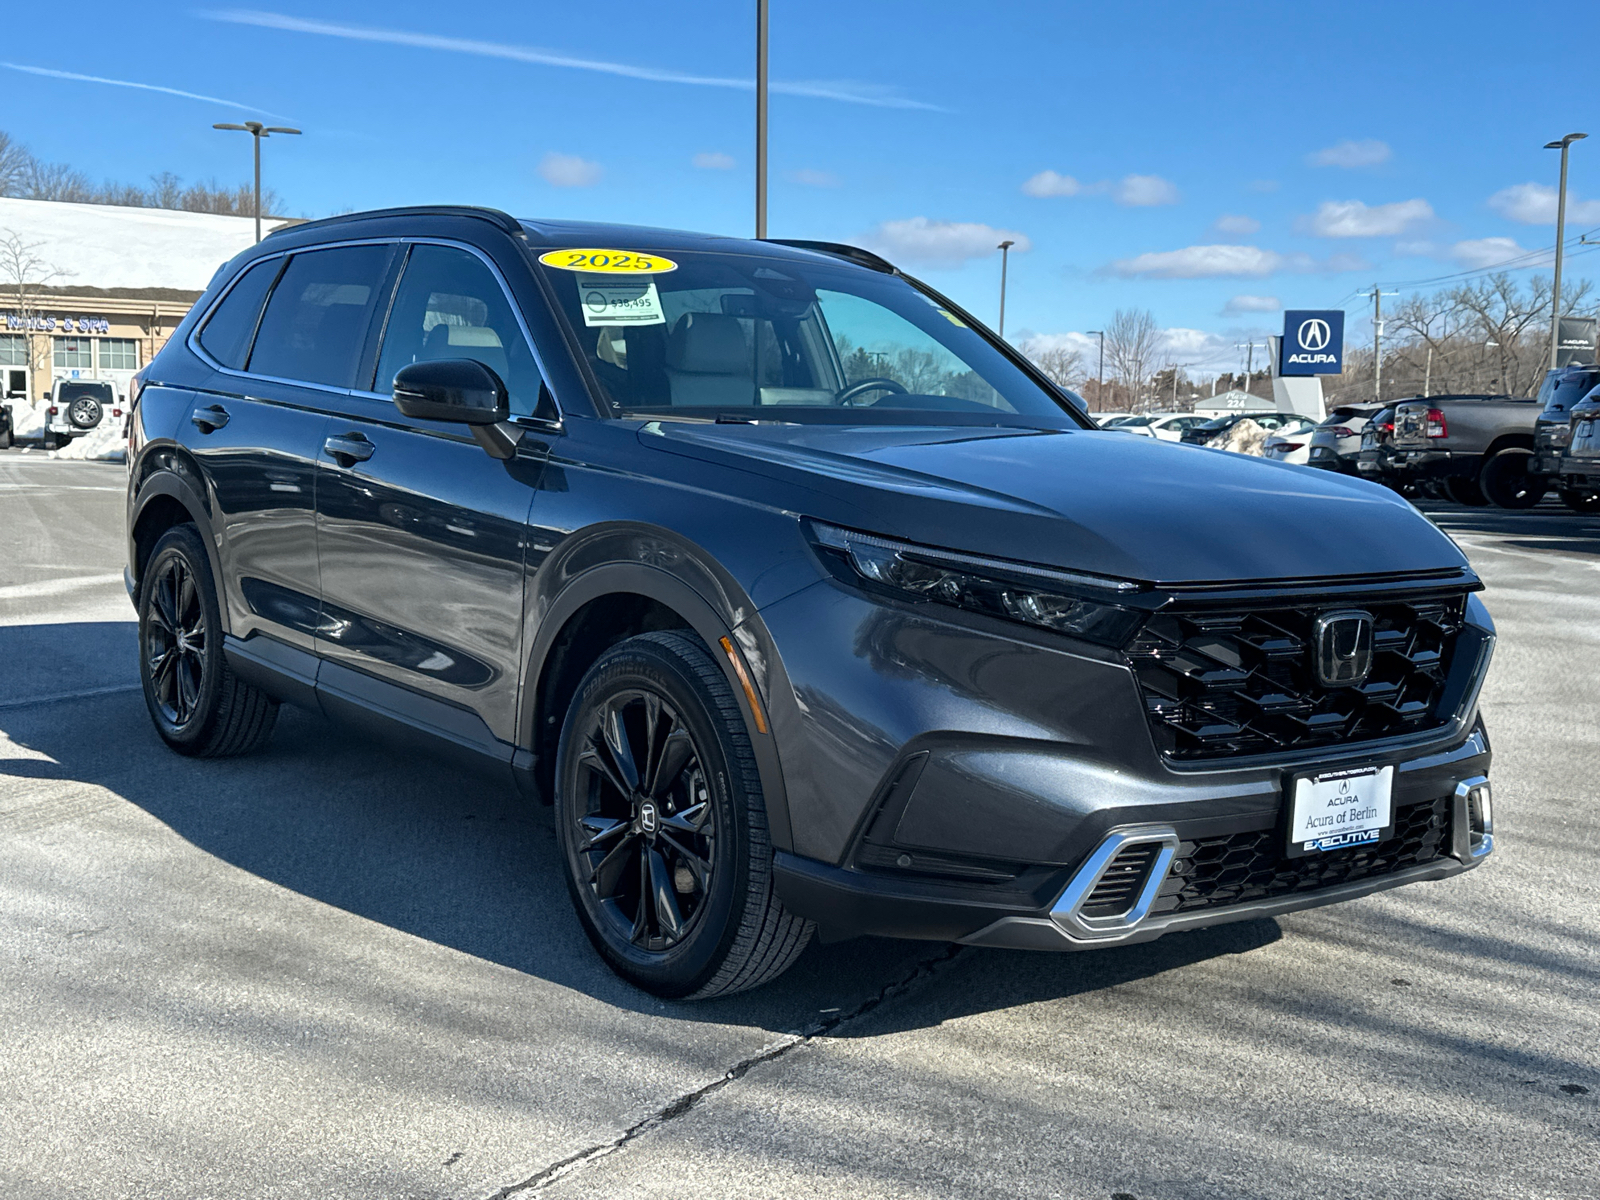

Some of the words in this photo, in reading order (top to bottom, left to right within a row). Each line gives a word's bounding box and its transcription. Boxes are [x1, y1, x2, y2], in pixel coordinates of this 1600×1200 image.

[567, 253, 653, 270] 2025
[611, 298, 652, 309] $38,495
[7, 312, 56, 330] NAILS
[64, 315, 74, 330] &
[79, 316, 110, 332] SPA
[1288, 353, 1337, 364] ACURA
[1226, 392, 1248, 400] Plaza
[1227, 399, 1245, 408] 224
[1327, 795, 1359, 808] ACURA
[1305, 815, 1334, 829] Acura
[1336, 811, 1347, 824] of
[1349, 806, 1378, 822] Berlin
[1303, 829, 1380, 851] EXECUTIVE
